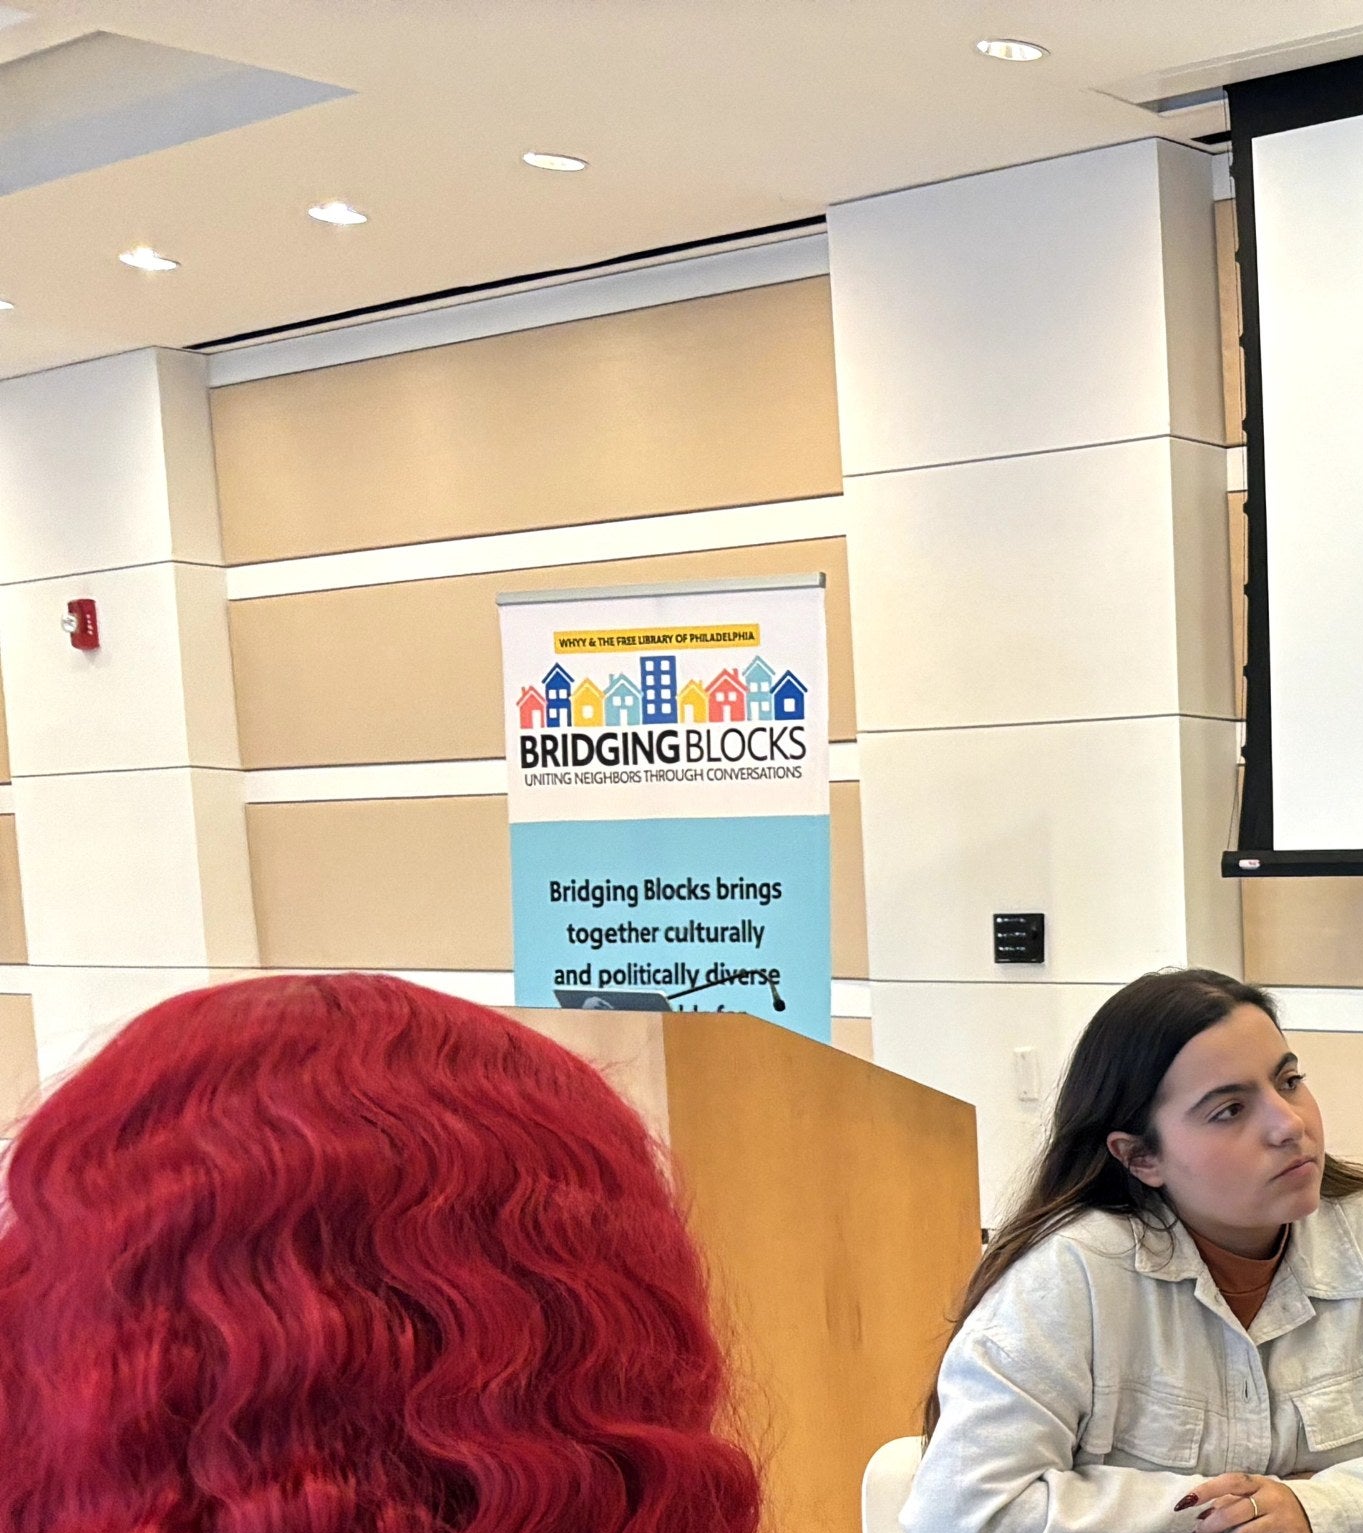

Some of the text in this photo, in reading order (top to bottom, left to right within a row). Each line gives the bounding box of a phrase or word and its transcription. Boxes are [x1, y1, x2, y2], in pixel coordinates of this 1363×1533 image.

[559, 631, 755, 648] WHYY & THE FREE LIBRARY OF PHILADELPHIA
[524, 766, 803, 787] UNITING NEIGHBORS THROUGH CONVERSATIONS
[549, 876, 783, 908] Bridging Blocks brings
[566, 919, 766, 950] together culturally
[553, 962, 782, 989] and politically diverse
